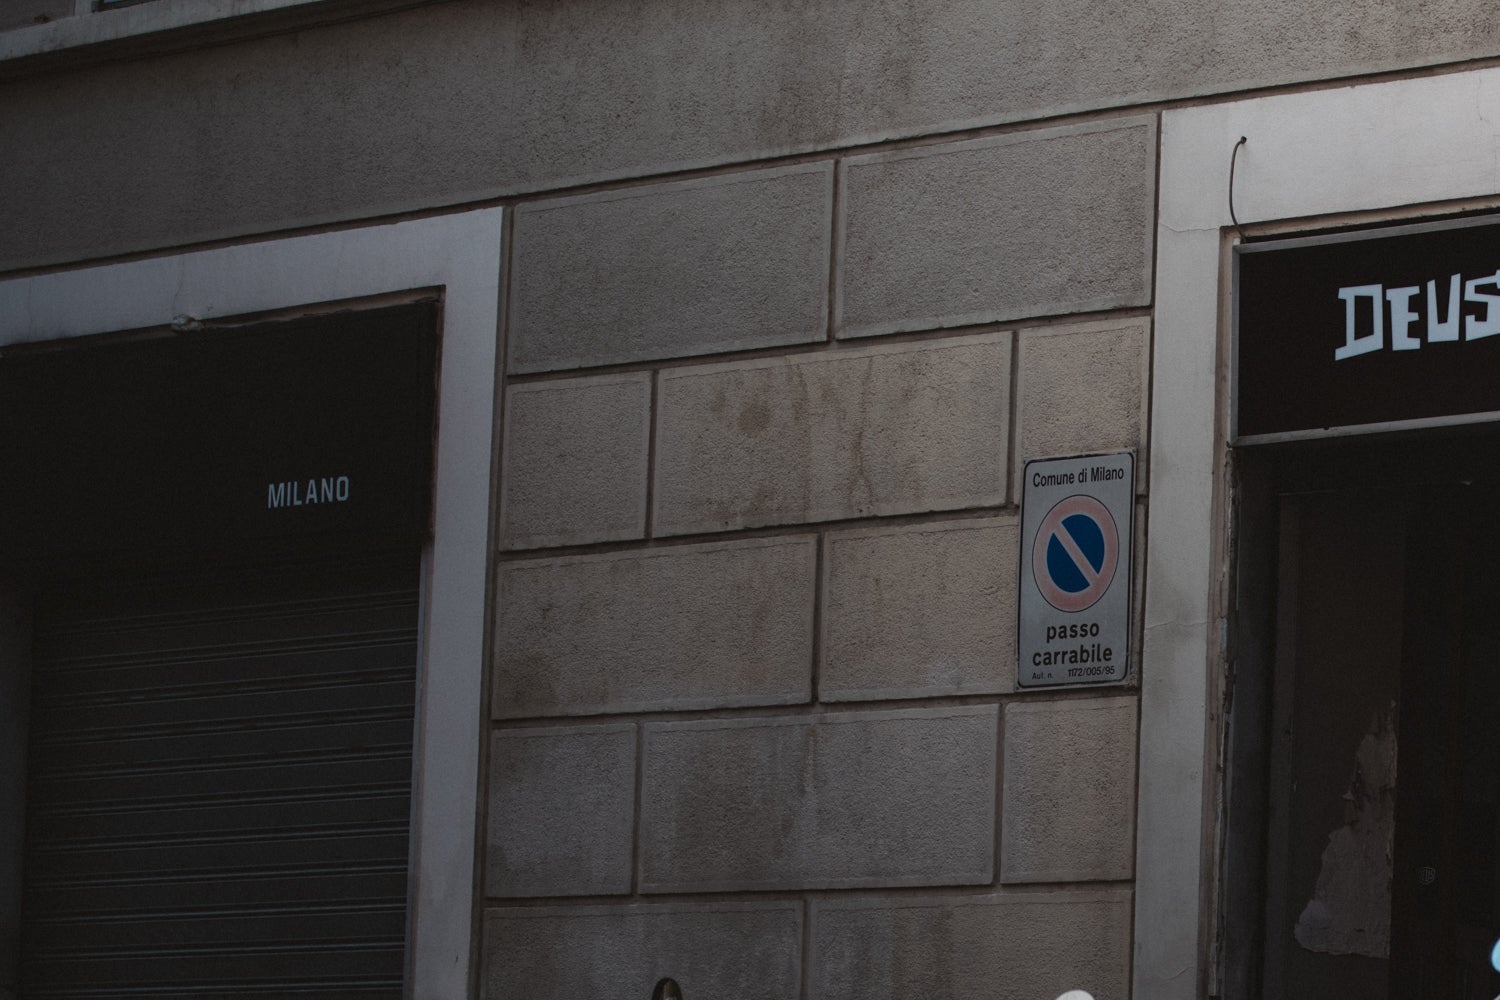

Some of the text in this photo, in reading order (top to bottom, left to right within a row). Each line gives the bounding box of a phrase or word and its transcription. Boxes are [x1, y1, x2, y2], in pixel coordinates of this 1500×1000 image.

[1033, 467, 1124, 488] Comune di Milano
[267, 475, 350, 509] MILANO
[1046, 623, 1100, 643] passo
[1032, 645, 1113, 666] carrabile
